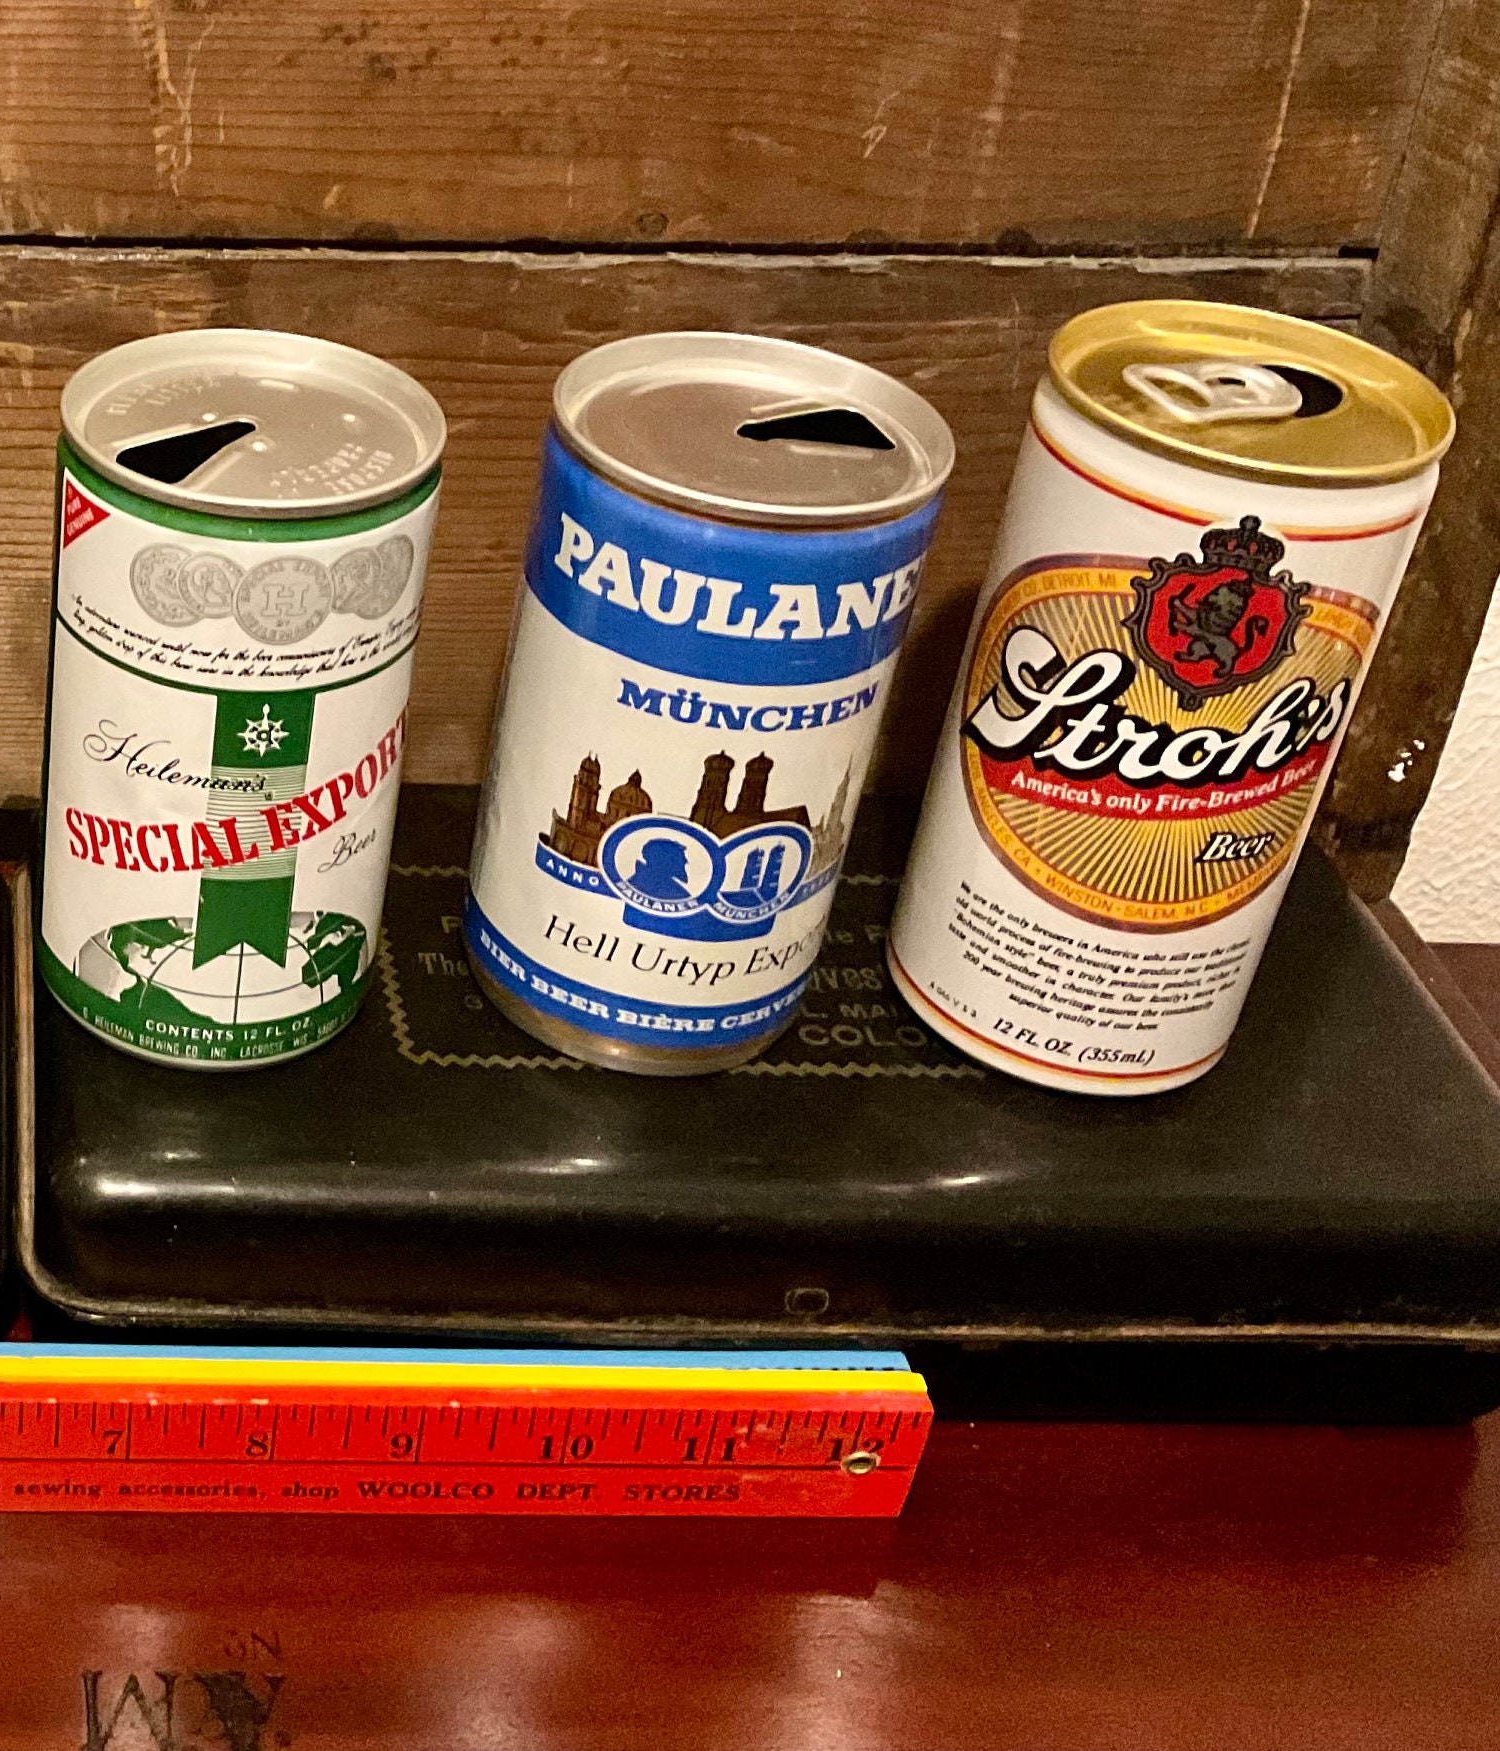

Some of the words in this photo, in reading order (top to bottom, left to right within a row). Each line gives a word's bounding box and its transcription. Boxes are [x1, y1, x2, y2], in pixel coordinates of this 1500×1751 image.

[554, 511, 928, 641] PAULANE
[618, 677, 879, 732] MÜNCHEN
[963, 626, 1350, 786] Stroh's
[83, 719, 268, 792] Heileman's
[65, 807, 260, 873] SPECIAL
[260, 701, 409, 852] EXPORT
[1011, 771, 1102, 807] America's
[1105, 792, 1152, 814] only
[1155, 775, 1278, 813] Fire-Brewed
[1281, 759, 1317, 788] Beer
[317, 828, 376, 873] Beer
[1200, 832, 1276, 863] Beer
[546, 858, 600, 886] ANNO
[615, 881, 700, 912] PAULANER
[545, 914, 620, 963] Hell
[631, 942, 735, 986] Urtyp
[744, 915, 826, 976] Expo
[970, 908, 997, 927] world
[997, 925, 1036, 947] process
[1038, 944, 1052, 953] of
[1053, 948, 1121, 974] fire-brewing
[989, 903, 1005, 916] the
[1007, 913, 1030, 929] only
[1076, 939, 1089, 950] in
[1092, 943, 1139, 961] America
[480, 928, 527, 982] BIER
[530, 974, 610, 1020] BEER
[616, 1012, 716, 1033] BIÈRE
[963, 950, 980, 966] 200
[1005, 974, 1047, 999] brewing
[1050, 992, 1096, 1011] heritage
[969, 940, 989, 955] and
[992, 953, 1041, 979] smoother
[1044, 976, 1056, 986] in
[1066, 969, 1074, 977] a
[1078, 970, 1106, 985] truly
[145, 1019, 235, 1042] CONTENTS
[244, 1028, 258, 1040] 12
[1009, 993, 1054, 1014] superior
[1055, 1010, 1096, 1027] quality
[1098, 1019, 1111, 1028] of
[1113, 1022, 1133, 1030] our
[95, 1014, 134, 1042] HEILEMAN
[139, 1033, 181, 1056] BREWING
[992, 1017, 1014, 1034] 12
[1044, 1038, 1071, 1056] OZ.
[102, 1429, 125, 1456] 7
[246, 1430, 270, 1458] 8
[390, 1432, 414, 1459] 9
[539, 1434, 595, 1461] 10
[681, 1436, 737, 1462] 11
[827, 1437, 885, 1463] 12
[13, 1479, 101, 1499] sewing
[118, 1480, 268, 1500] accessories,
[280, 1482, 340, 1501] shop
[357, 1480, 494, 1500] WOOLCO
[622, 1484, 741, 1502] STORES
